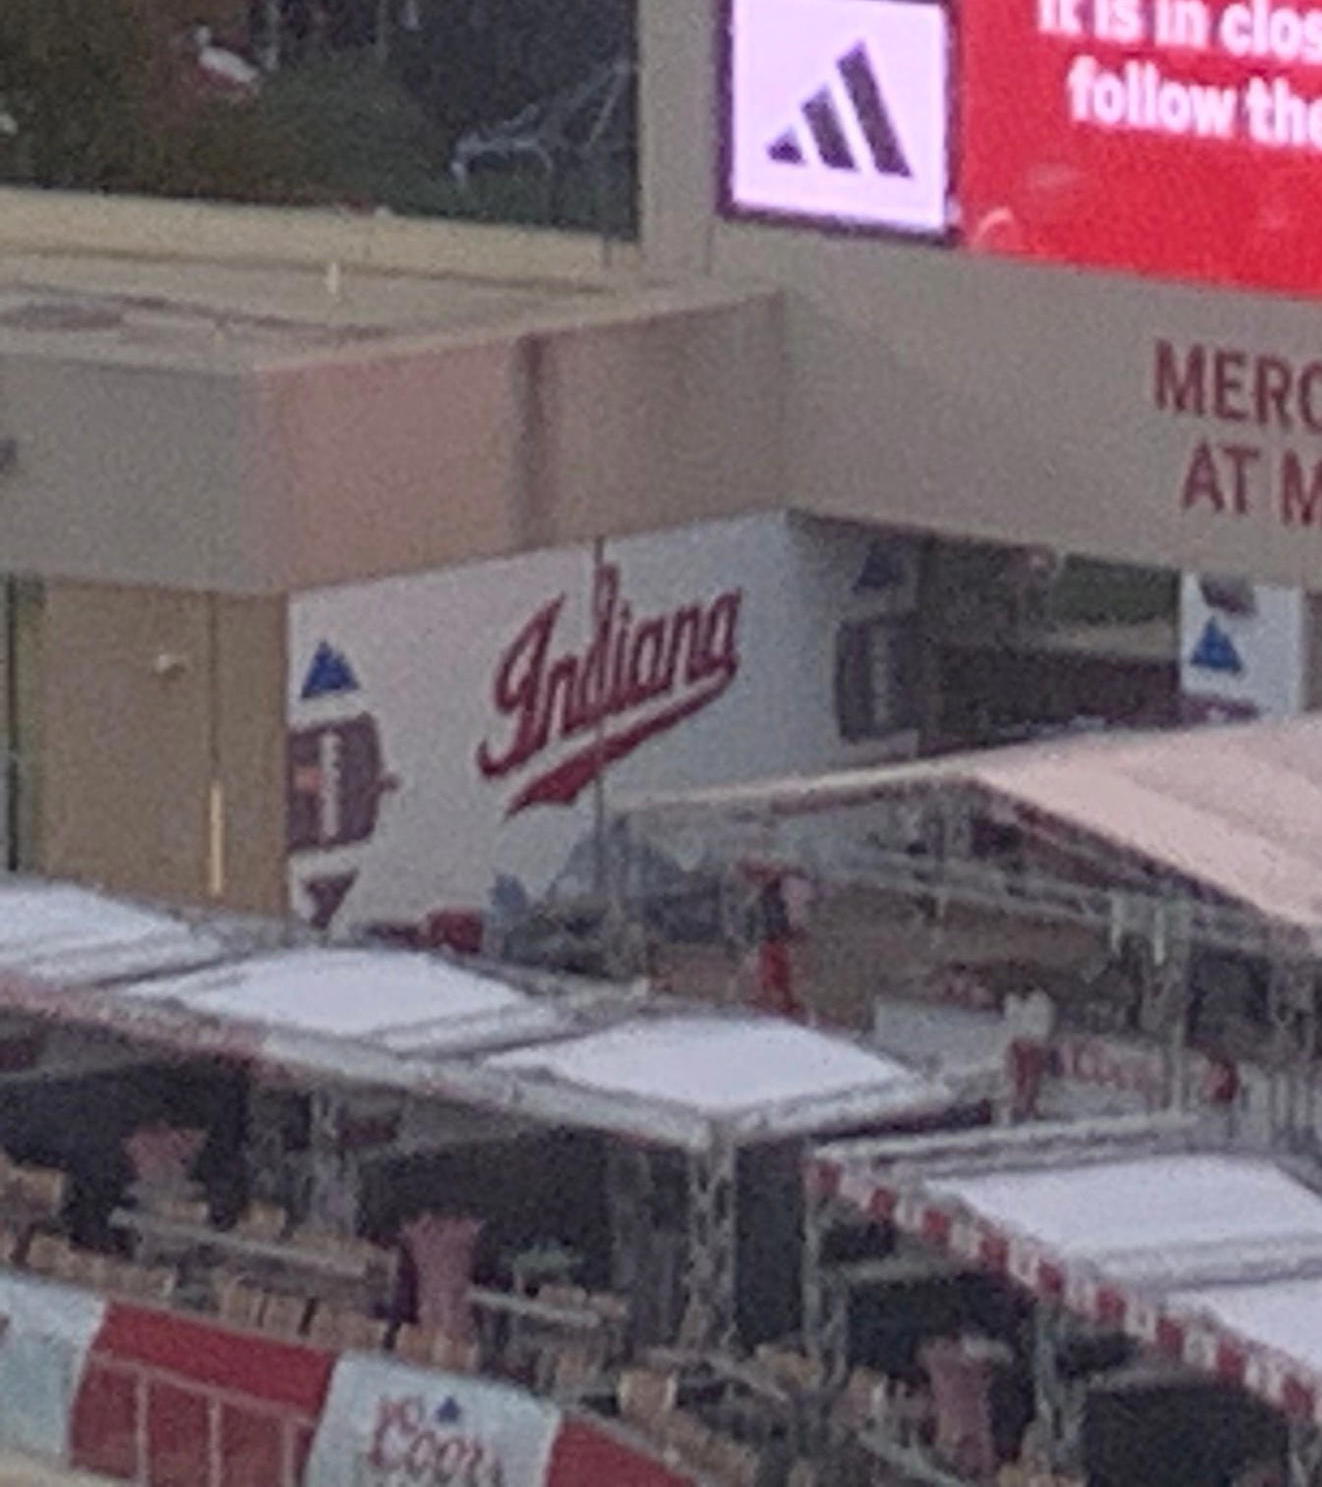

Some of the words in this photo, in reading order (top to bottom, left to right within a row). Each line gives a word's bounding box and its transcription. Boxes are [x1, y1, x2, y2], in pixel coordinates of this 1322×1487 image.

[1068, 56, 1236, 139] follow
[1182, 441, 1262, 517] AT
[476, 562, 742, 783] Indiana
